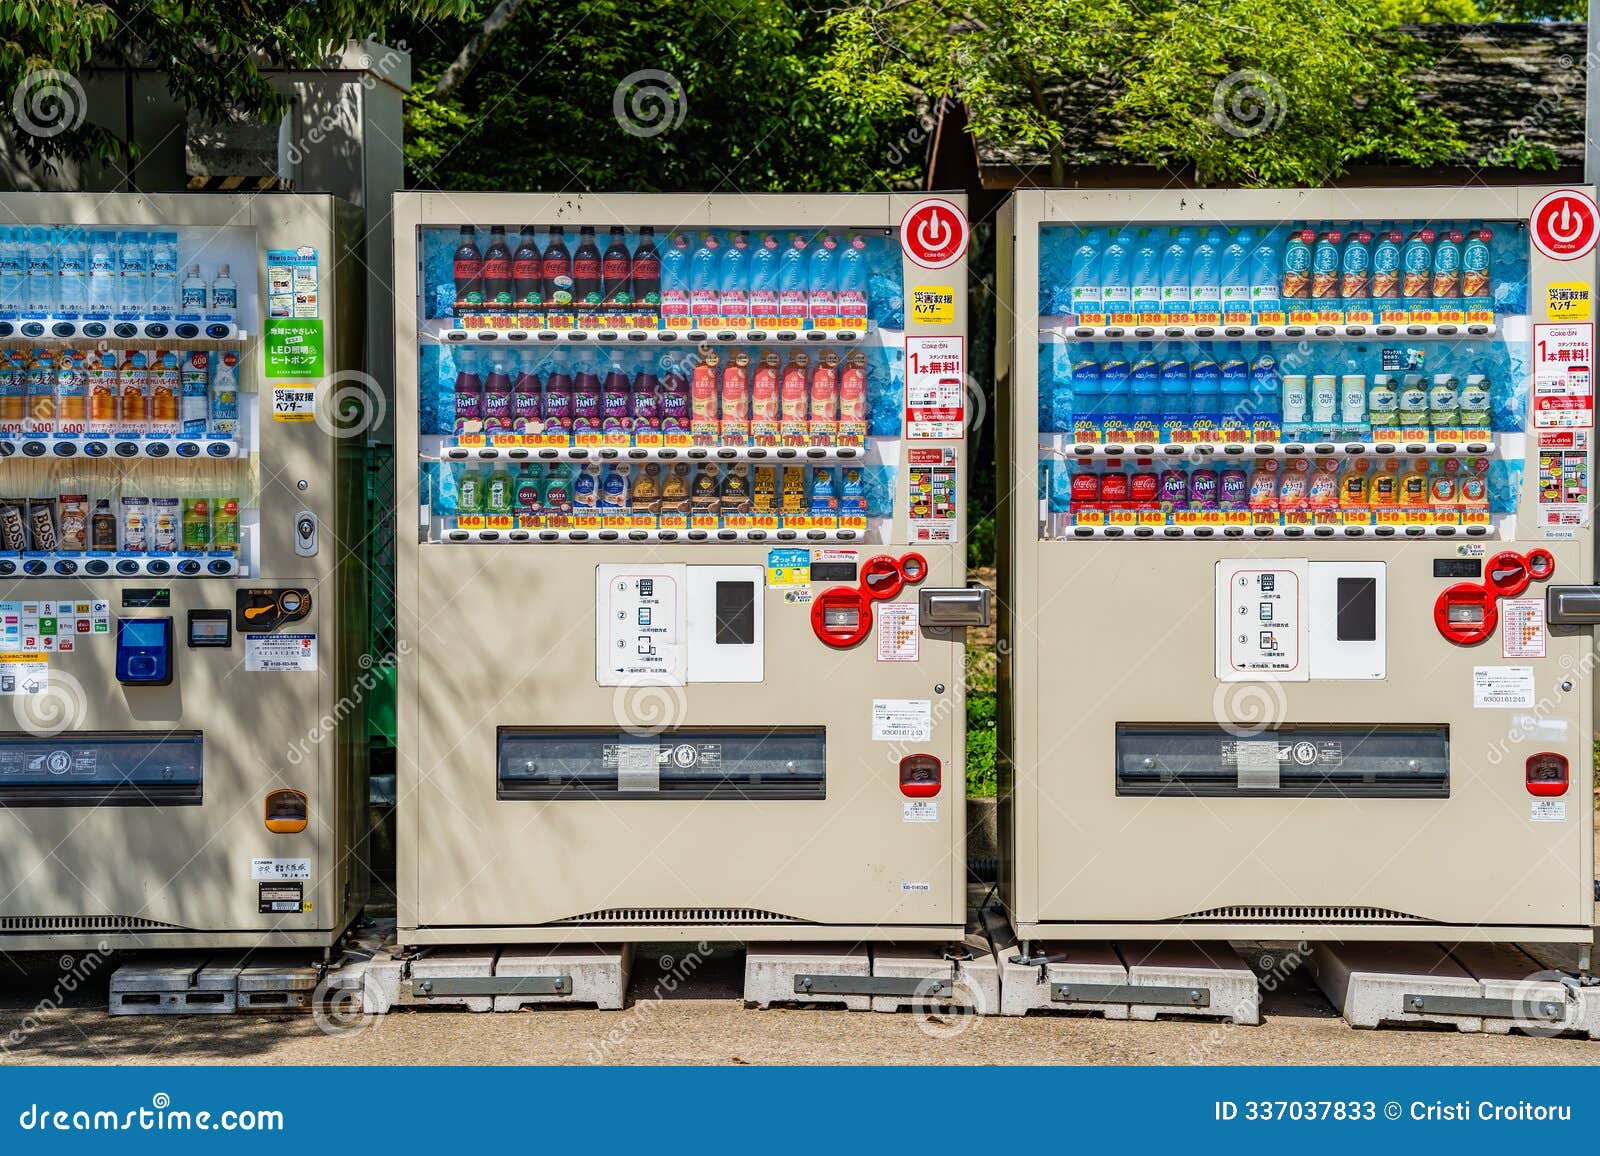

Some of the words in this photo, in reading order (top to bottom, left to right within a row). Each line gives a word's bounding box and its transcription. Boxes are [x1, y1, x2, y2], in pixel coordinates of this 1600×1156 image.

[914, 291, 952, 304] 災害救援
[1549, 288, 1589, 301] 災害救援
[915, 304, 942, 313] ベンダー
[1550, 301, 1577, 310] ベンダー
[1080, 314, 1101, 323] 130
[1111, 314, 1132, 323] 130
[1140, 314, 1161, 323] 130
[1168, 314, 1189, 323] 130
[1194, 314, 1216, 323] 130
[1225, 314, 1247, 323] 130
[1259, 314, 1280, 323] 130
[1290, 312, 1312, 321] 140
[1318, 312, 1339, 321] 140
[1347, 312, 1368, 321] 140
[1382, 312, 1403, 321] 140
[1410, 312, 1431, 321] 140
[1438, 312, 1459, 321] 140
[1467, 312, 1488, 321] 140
[667, 318, 688, 327] 160
[699, 318, 719, 327] 160
[726, 318, 747, 327] 160
[755, 318, 777, 327] 160
[777, 318, 798, 327] 160
[814, 318, 836, 327] 160
[841, 318, 862, 327] 160
[271, 356, 317, 365] ヒートポンプ
[274, 389, 314, 402] 災害救援
[276, 402, 303, 411] ベンダー
[460, 435, 480, 445] 160
[494, 435, 516, 445] 160
[521, 435, 542, 445] 160
[548, 435, 564, 445] 60
[576, 435, 597, 445] 160
[637, 435, 658, 445] 160
[665, 435, 686, 445] 160
[1374, 430, 1396, 440] 160
[1403, 430, 1424, 440] 160
[1435, 430, 1457, 440] 160
[1464, 430, 1486, 440] 160
[1073, 478, 1097, 489] Coca-Cola
[1133, 478, 1156, 489] Coca-Cola
[1102, 485, 1125, 495] Coca-Cola
[458, 516, 480, 526] 140
[487, 516, 509, 526] 140
[575, 516, 597, 526] 150
[603, 516, 625, 526] 150
[692, 516, 713, 526] 140
[725, 516, 747, 526] 140
[752, 516, 774, 526] 140
[784, 516, 806, 526] 140
[811, 516, 832, 526] 140
[840, 516, 862, 526] 140
[1078, 513, 1099, 522] 140
[1110, 513, 1132, 522] 140
[1140, 513, 1161, 522] 140
[1175, 513, 1196, 522] 140
[1225, 513, 1247, 522] 140
[1345, 512, 1366, 522] 150
[1378, 512, 1399, 522] 150
[1405, 512, 1427, 522] 150
[1433, 512, 1455, 522] 140
[1463, 512, 1485, 522] 140
[7, 514, 25, 551] BOSS
[37, 513, 56, 551] BOSS
